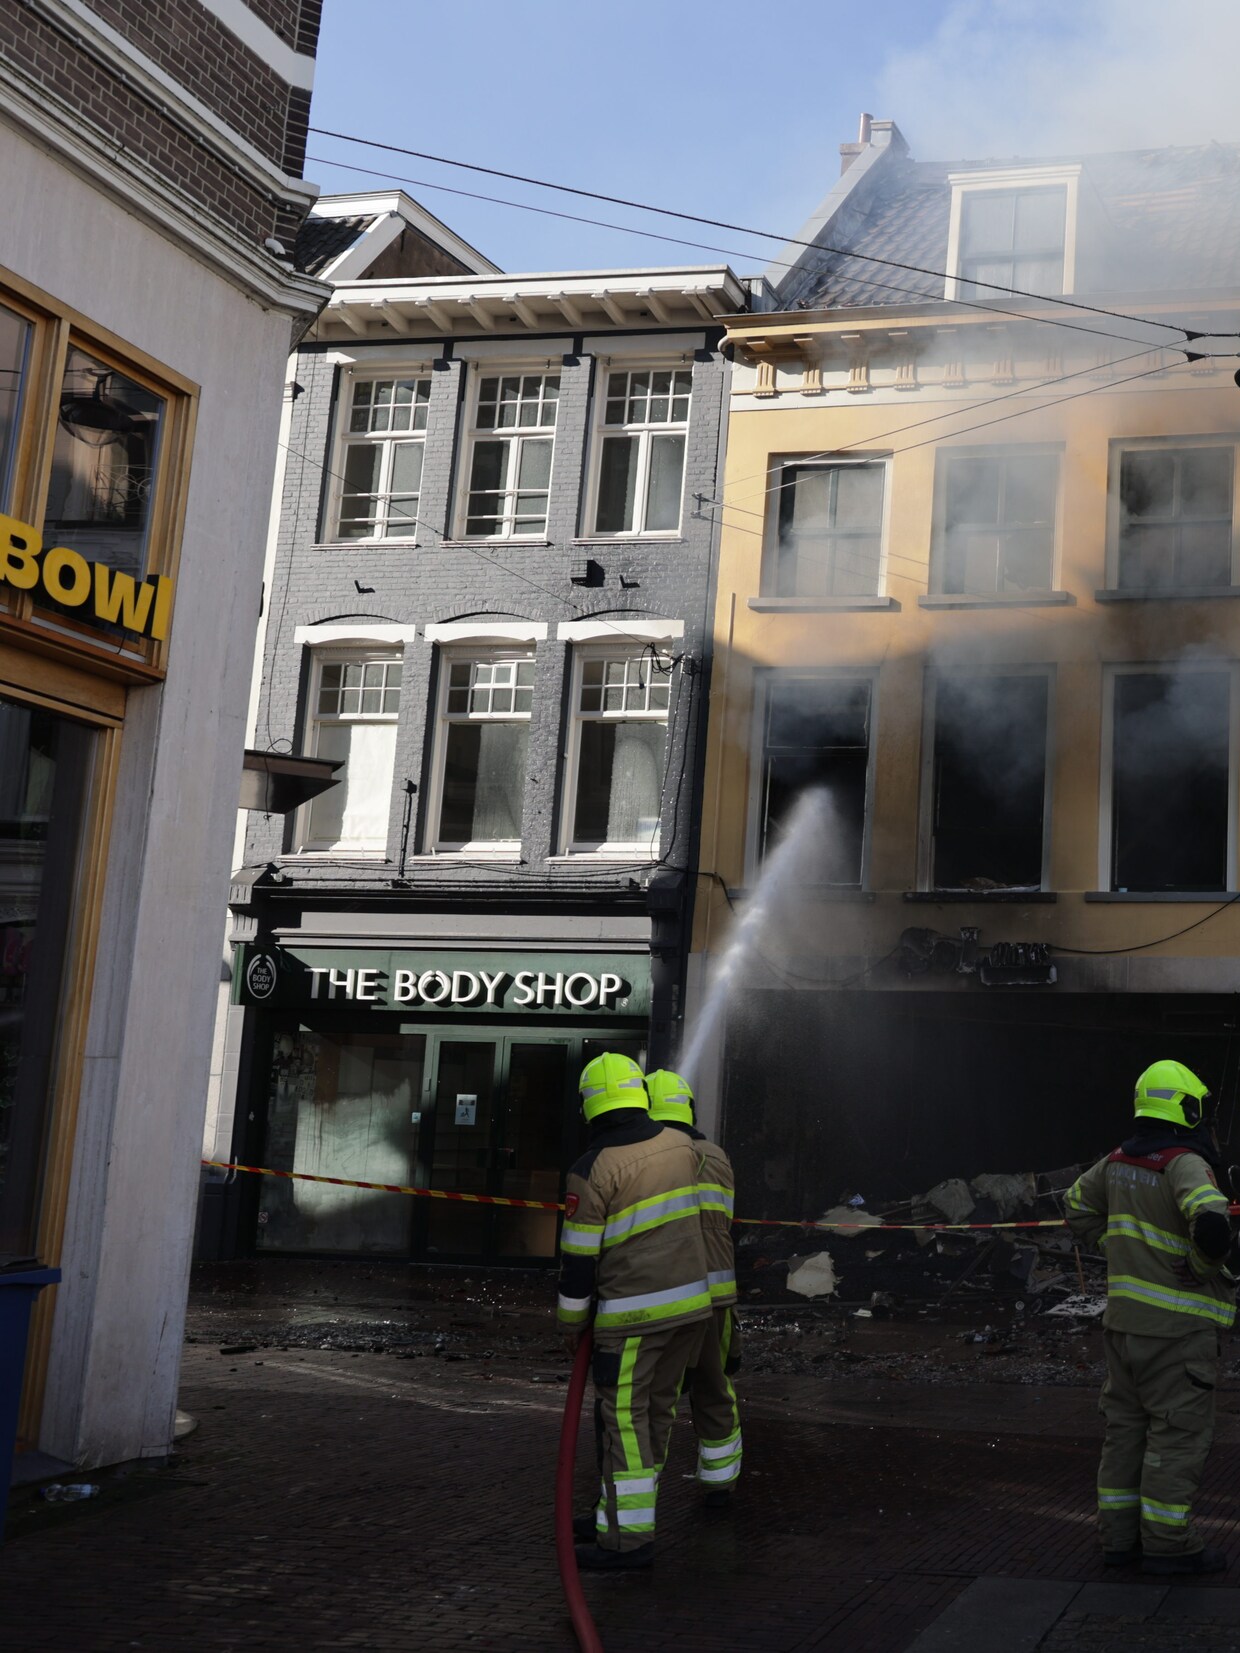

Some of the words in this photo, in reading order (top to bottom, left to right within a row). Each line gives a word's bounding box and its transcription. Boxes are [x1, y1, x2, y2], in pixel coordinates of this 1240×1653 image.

[257, 967, 268, 975] THE
[252, 974, 271, 983] BODY
[252, 982, 270, 991] SHOP
[304, 968, 381, 1000] THE
[394, 969, 505, 1003] BODY
[513, 971, 622, 1005] SHOP
